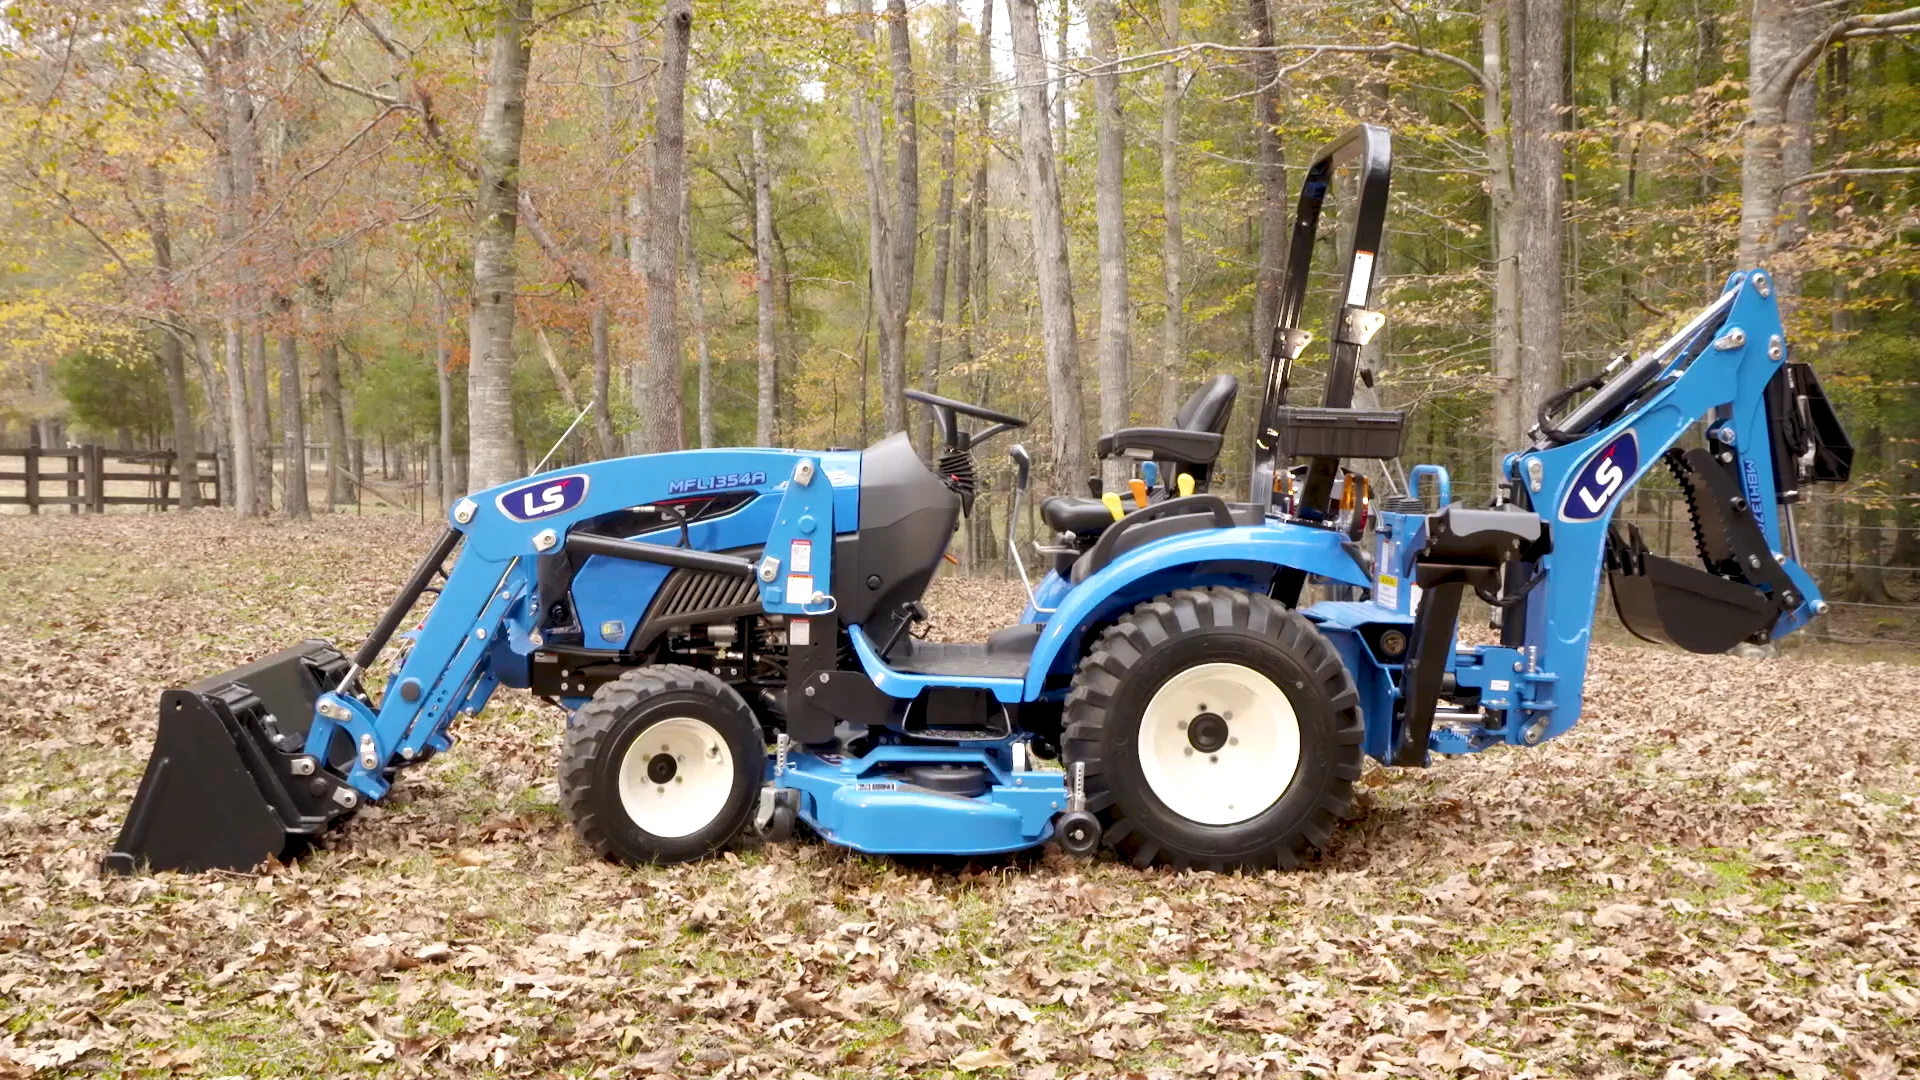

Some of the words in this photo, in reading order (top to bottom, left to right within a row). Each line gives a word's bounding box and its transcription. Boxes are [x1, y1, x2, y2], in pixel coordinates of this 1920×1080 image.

[669, 472, 766, 493] MFL1354A
[1579, 455, 1623, 513] LS
[524, 483, 565, 516] LS
